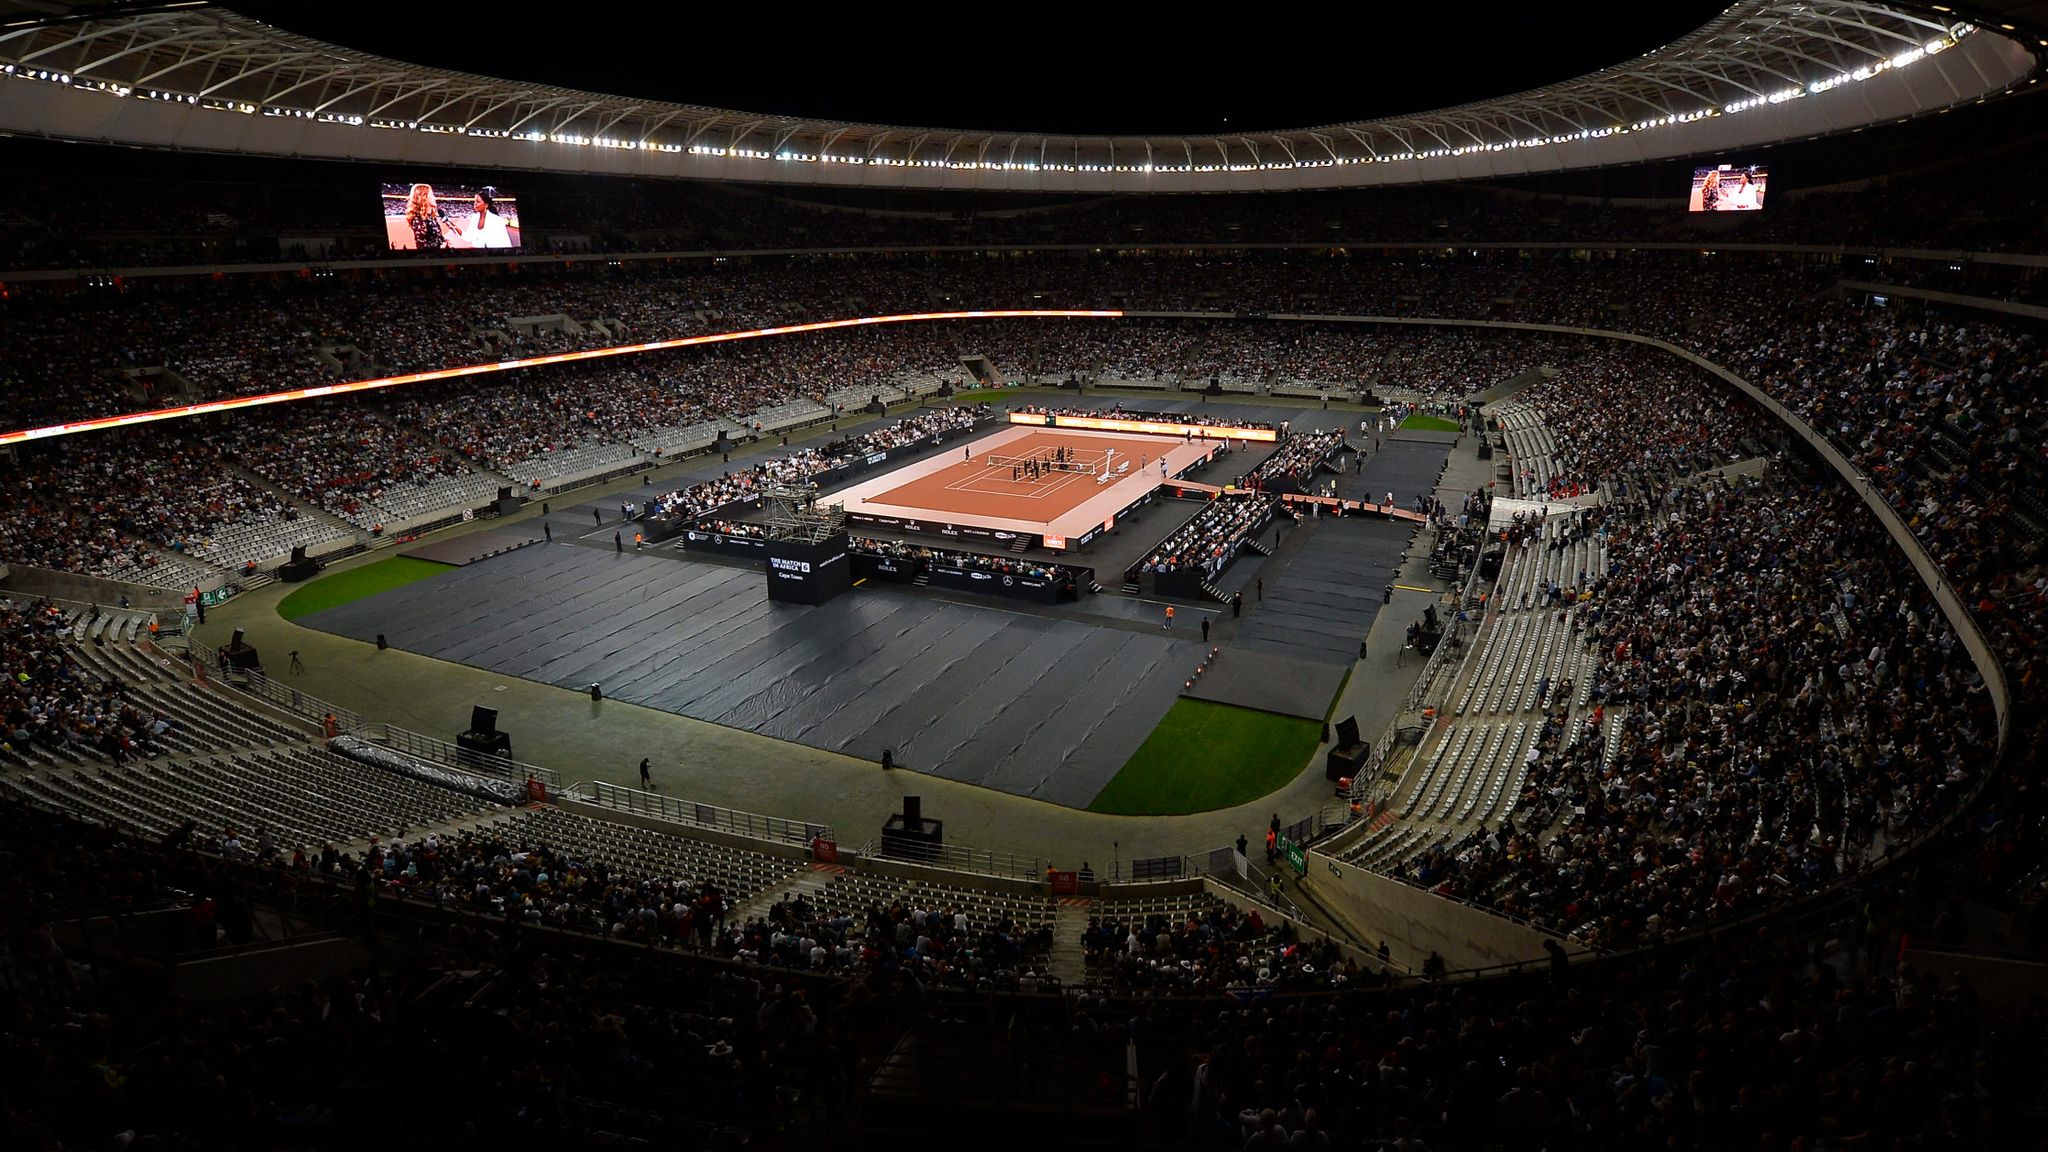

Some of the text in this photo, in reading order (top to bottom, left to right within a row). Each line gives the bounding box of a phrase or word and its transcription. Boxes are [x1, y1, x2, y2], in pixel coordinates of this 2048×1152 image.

[781, 559, 802, 567] MATCH
[877, 564, 898, 572] ROLEX
[790, 573, 804, 581] Town
[1291, 851, 1303, 866] EXIT
